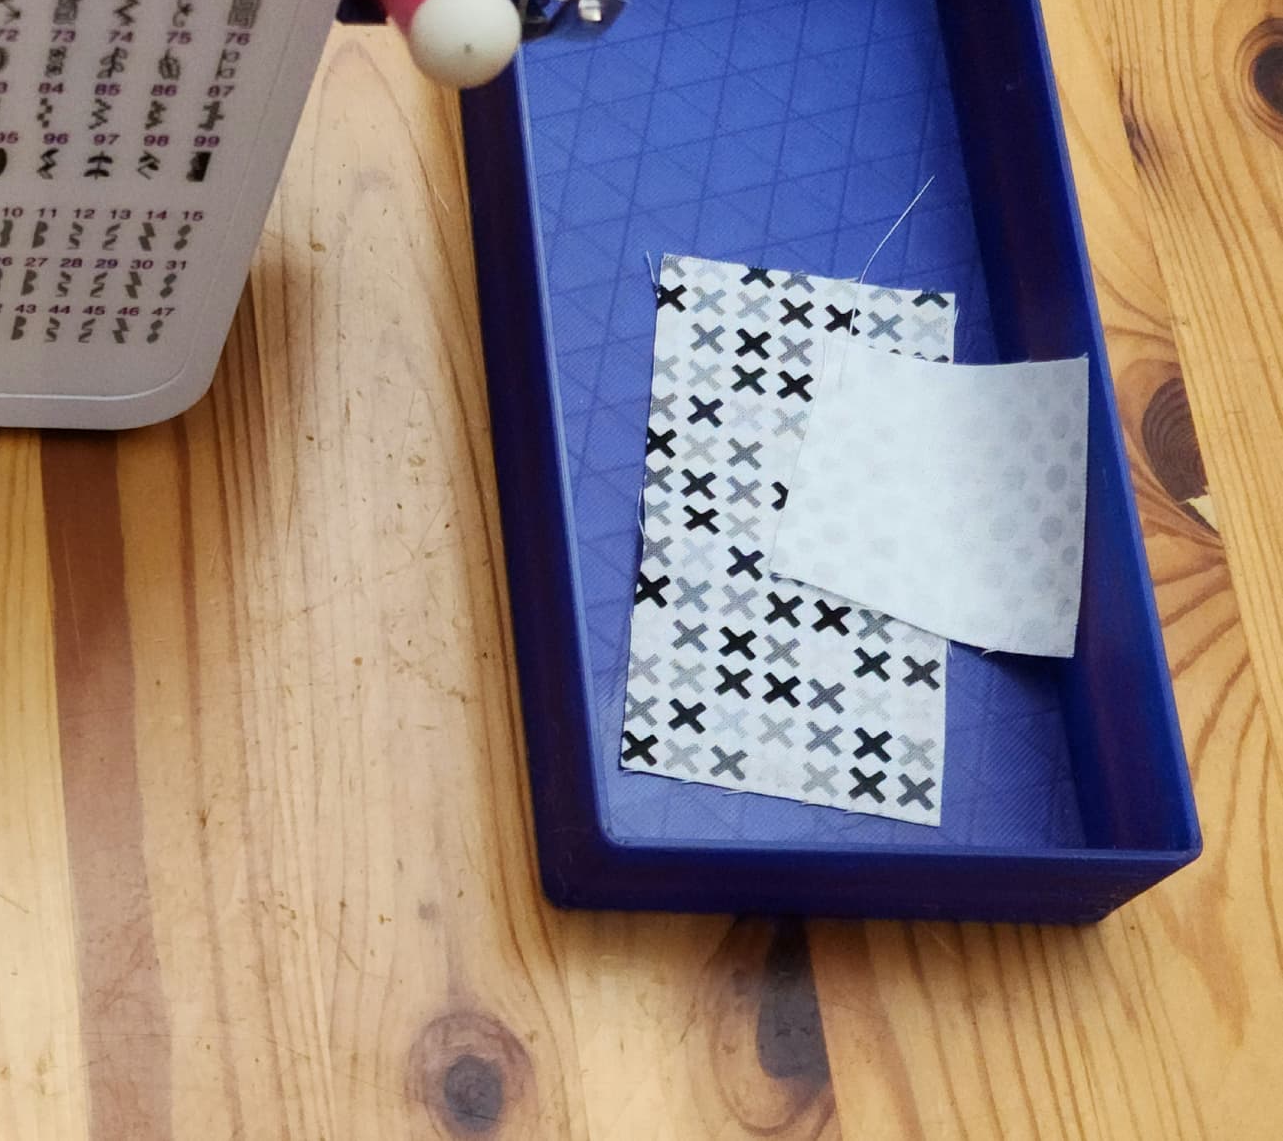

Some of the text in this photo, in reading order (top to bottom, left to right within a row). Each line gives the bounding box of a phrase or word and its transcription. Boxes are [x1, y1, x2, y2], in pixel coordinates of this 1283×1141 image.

[50, 30, 76, 43] 73
[108, 31, 134, 44] 74
[166, 32, 192, 45] 75
[224, 32, 251, 46] 76
[38, 82, 65, 95] 84
[94, 83, 122, 96] 85
[150, 84, 178, 97] 86
[207, 85, 235, 98] 87
[43, 133, 69, 145] 96
[93, 134, 121, 146] 97
[143, 135, 170, 147] 98
[194, 135, 221, 148] 99
[2, 207, 24, 218] 10
[38, 208, 58, 218] 11
[74, 208, 96, 220] 12
[110, 209, 133, 220] 13
[146, 209, 168, 220] 14
[183, 210, 204, 222] 15
[25, 257, 49, 268] 27
[60, 258, 84, 268] 28
[95, 258, 119, 269] 29
[130, 259, 154, 270] 30
[165, 259, 188, 270] 31
[14, 304, 37, 314] 43
[48, 305, 71, 315] 44
[83, 306, 106, 316] 45
[117, 307, 140, 316] 46
[152, 307, 176, 317] 47
